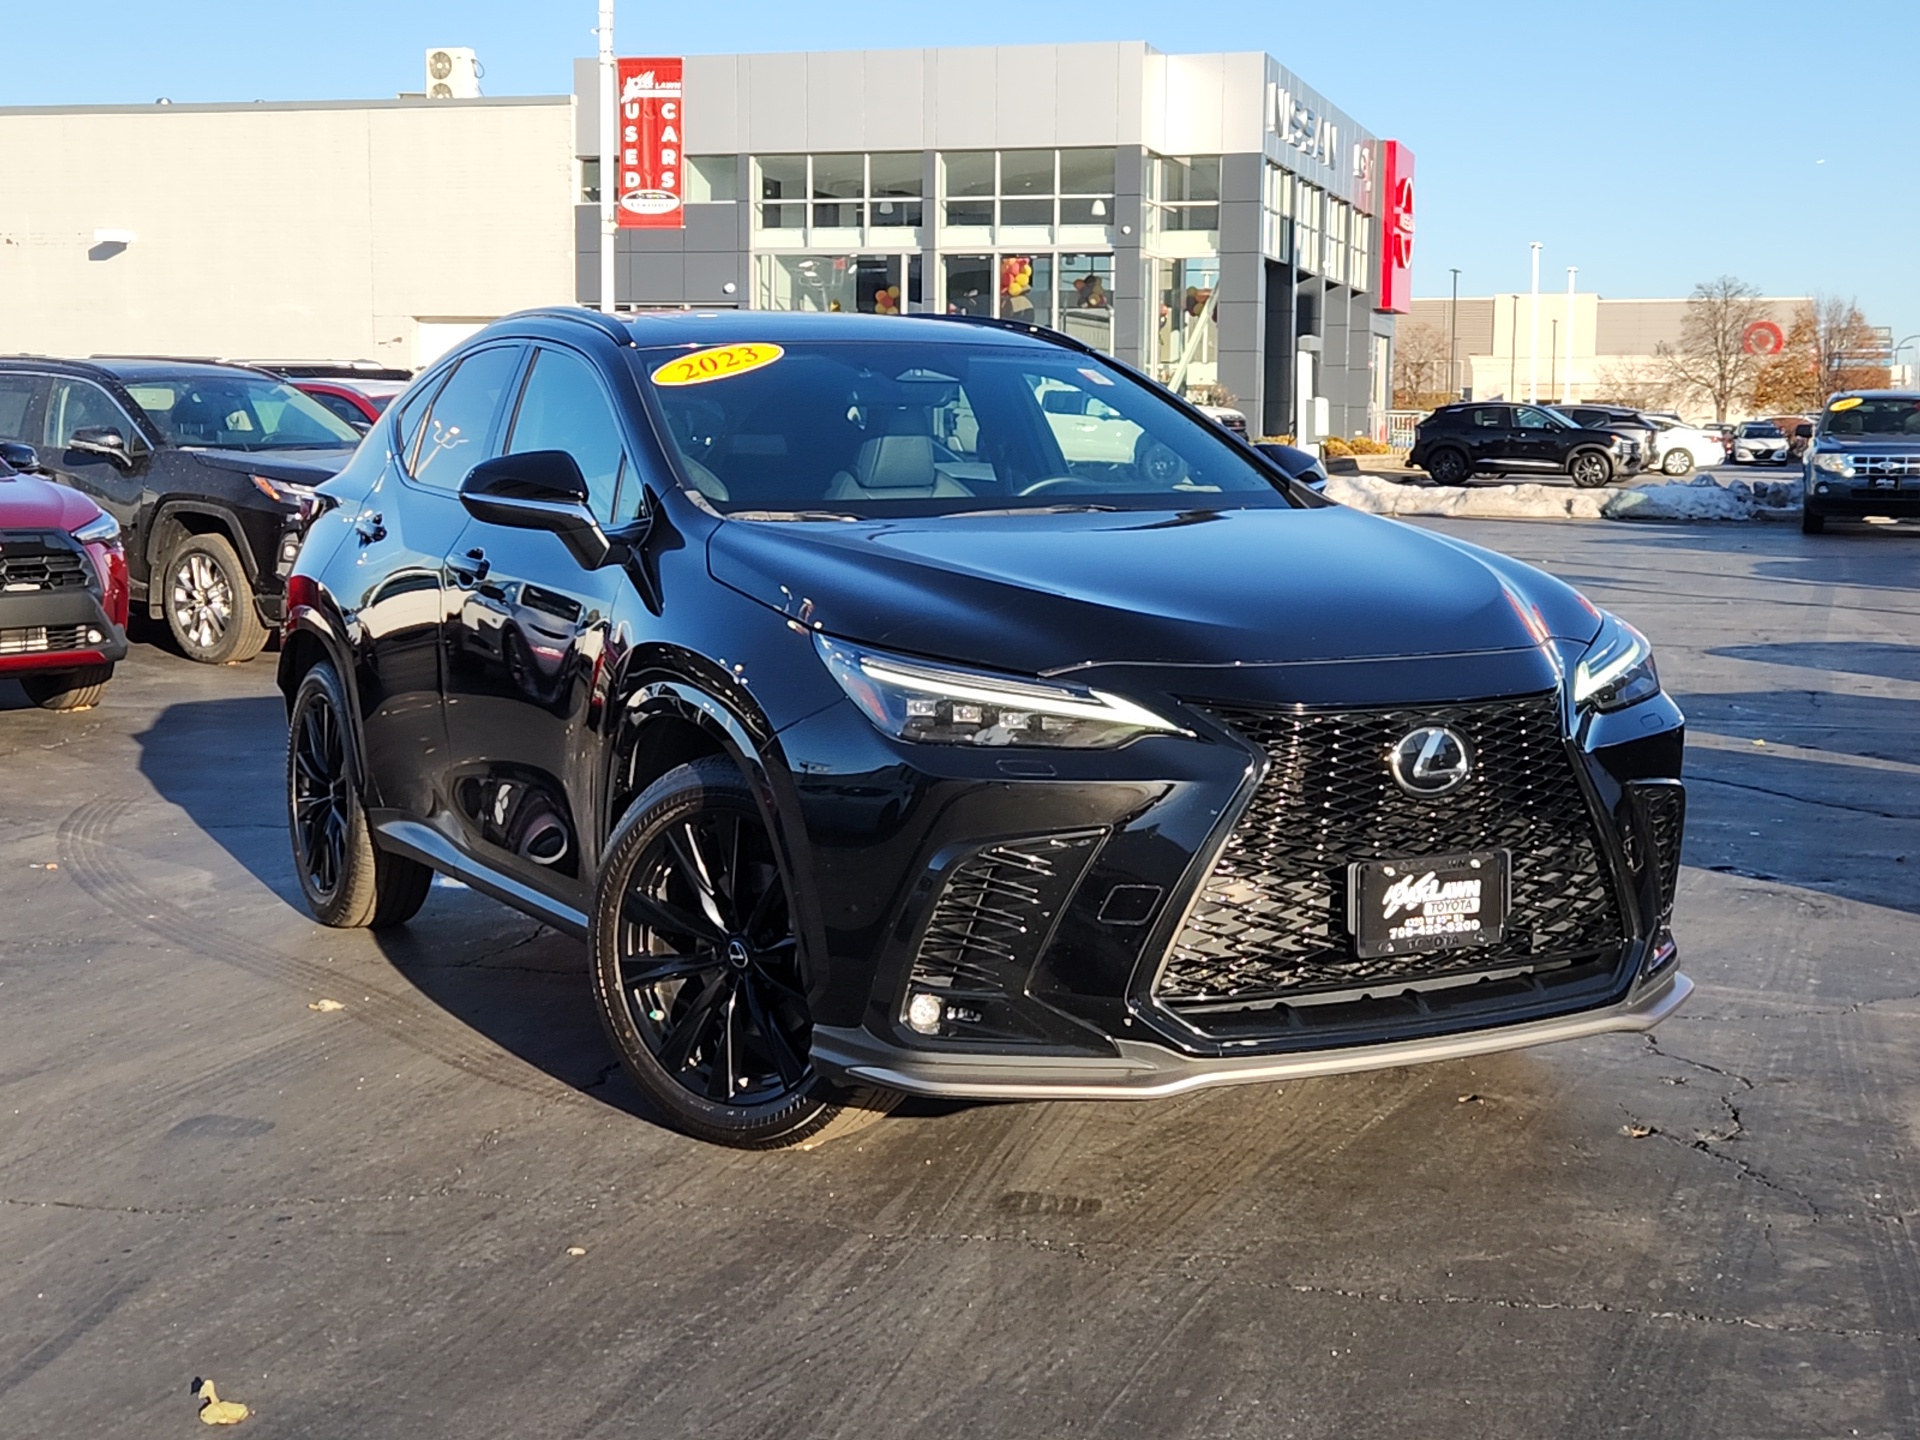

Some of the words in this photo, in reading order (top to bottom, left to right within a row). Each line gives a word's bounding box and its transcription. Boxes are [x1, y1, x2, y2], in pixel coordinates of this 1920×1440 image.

[625, 102, 640, 188] USED
[661, 102, 678, 188] CARS
[677, 347, 759, 381] 2023
[1431, 901, 1473, 914] TOYOTA
[1407, 936, 1460, 950] TOYOTA
